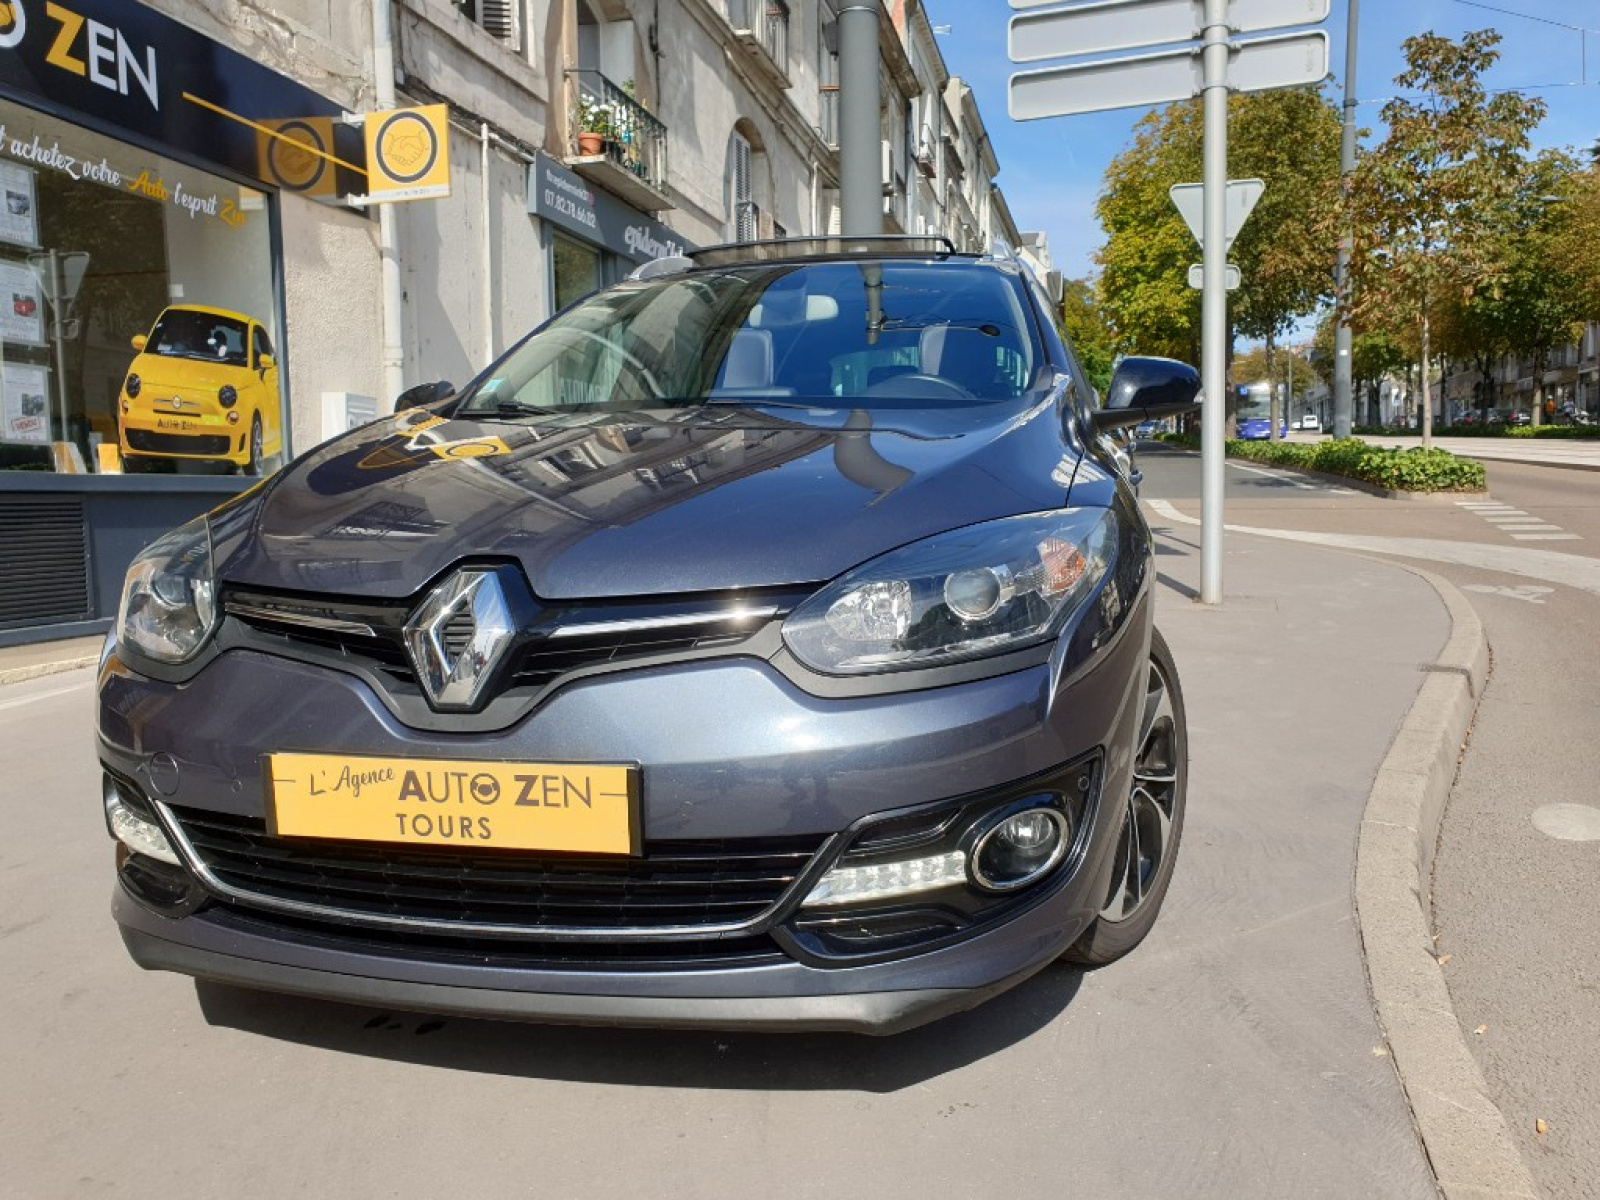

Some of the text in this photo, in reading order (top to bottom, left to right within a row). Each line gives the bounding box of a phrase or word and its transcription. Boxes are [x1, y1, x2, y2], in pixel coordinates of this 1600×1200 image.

[45, 2, 159, 112] ZEN
[11, 136, 80, 180] achetez
[83, 158, 120, 186] votre
[128, 171, 168, 200] Auto
[398, 769, 500, 806] AUTO
[514, 774, 592, 809] ZEN
[395, 813, 492, 840] TOURS
